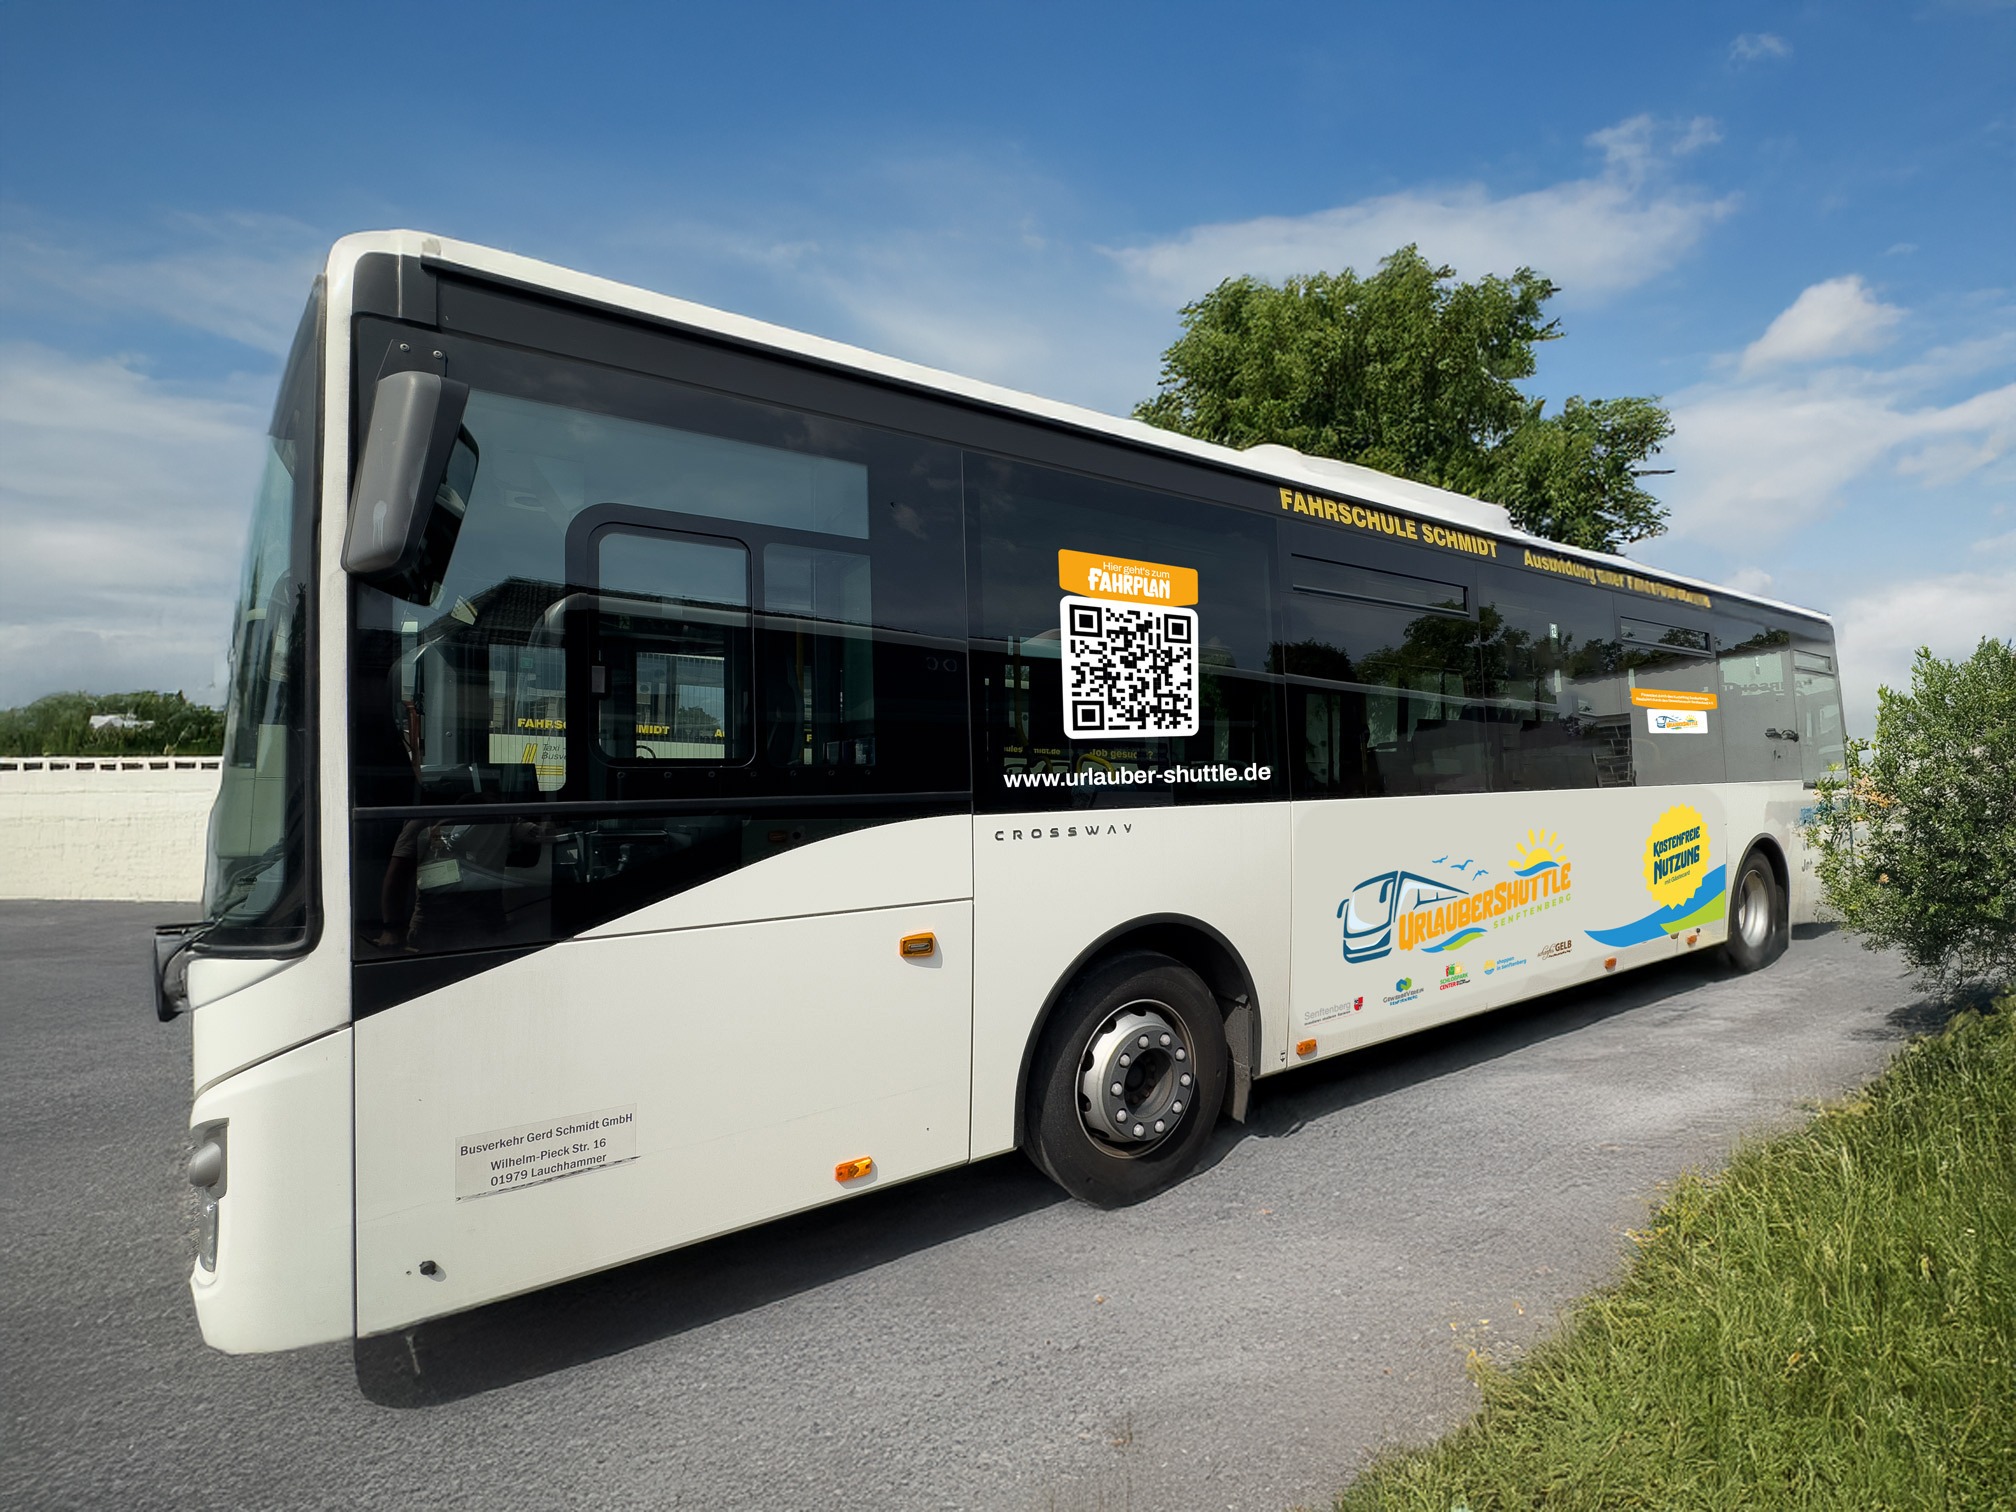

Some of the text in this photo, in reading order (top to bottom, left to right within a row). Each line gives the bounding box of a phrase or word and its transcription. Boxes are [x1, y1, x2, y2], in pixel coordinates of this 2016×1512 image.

[1279, 487, 1497, 557] FAHRSCHULE SCHMIDT
[1088, 567, 1171, 599] FAHRPLAN
[1103, 562, 1170, 579] Hier geht's zum
[636, 724, 670, 735] MIDT
[1003, 763, 1272, 788] www.urlauber-shuttle.de
[995, 824, 1132, 841] CROSSWAY
[1653, 825, 1700, 857] KOSTENFREIE
[1654, 845, 1700, 885] NUTZUNG
[1493, 893, 1572, 929] SENFTENBERG
[1555, 940, 1572, 952] GELB
[1439, 981, 1456, 991] CENTER
[1304, 1002, 1351, 1021] Senftenberg
[460, 1113, 633, 1156] Busverkehr Gerd Schmidt GmbH
[490, 1138, 606, 1171] Wilhelm-Pieck Str. 16
[490, 1154, 607, 1187] 01979 Lauchhammer
